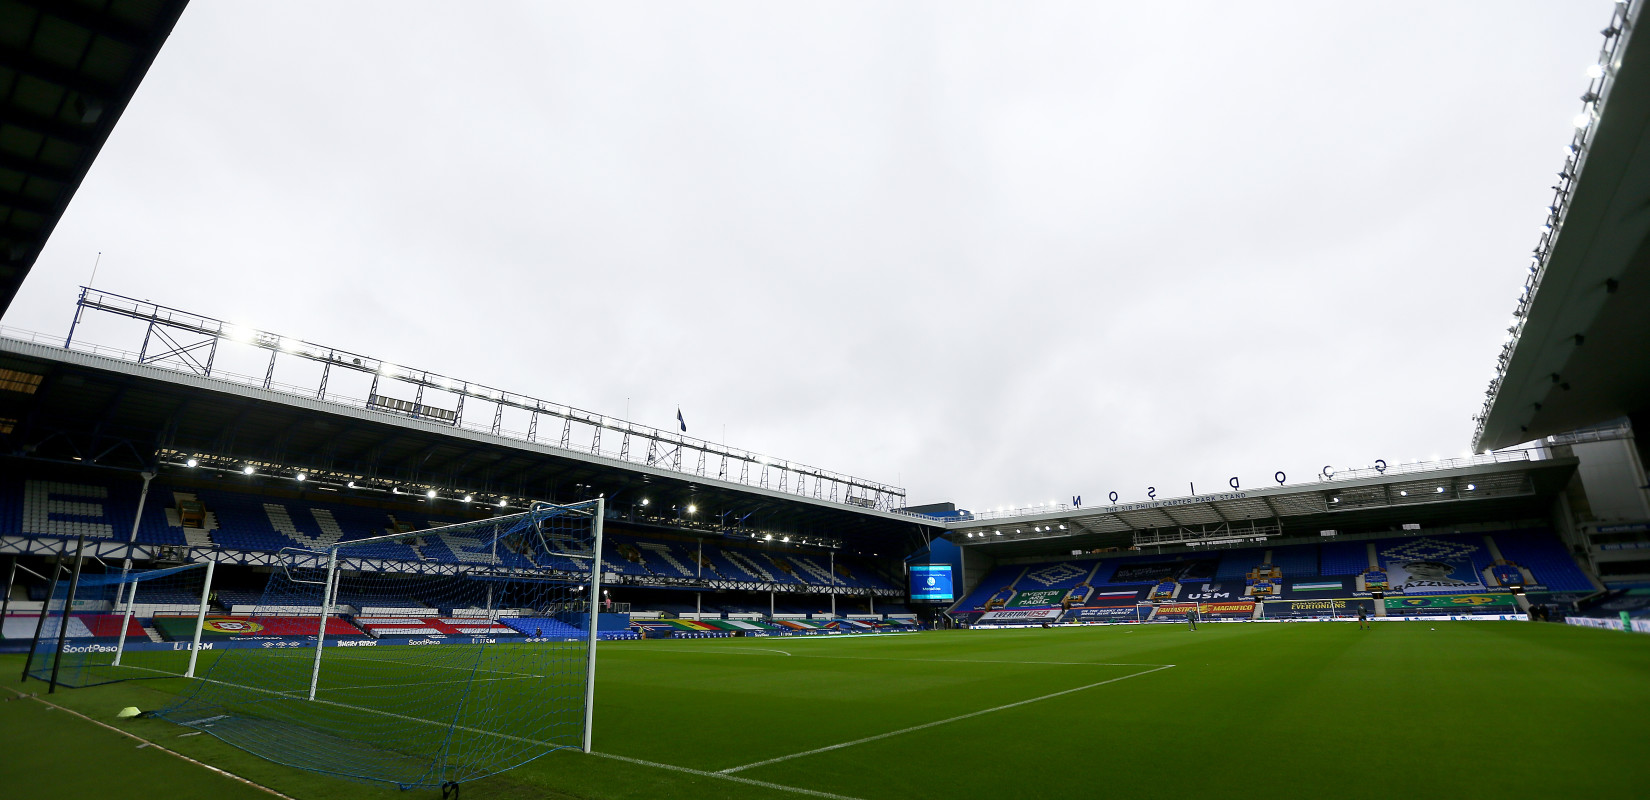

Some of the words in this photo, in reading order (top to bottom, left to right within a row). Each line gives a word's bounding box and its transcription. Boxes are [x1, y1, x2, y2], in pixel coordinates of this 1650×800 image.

[1136, 502, 1159, 510] PHILIP
[1162, 499, 1192, 507] CARTER
[1219, 492, 1246, 501] STAND
[1187, 592, 1230, 600] USM
